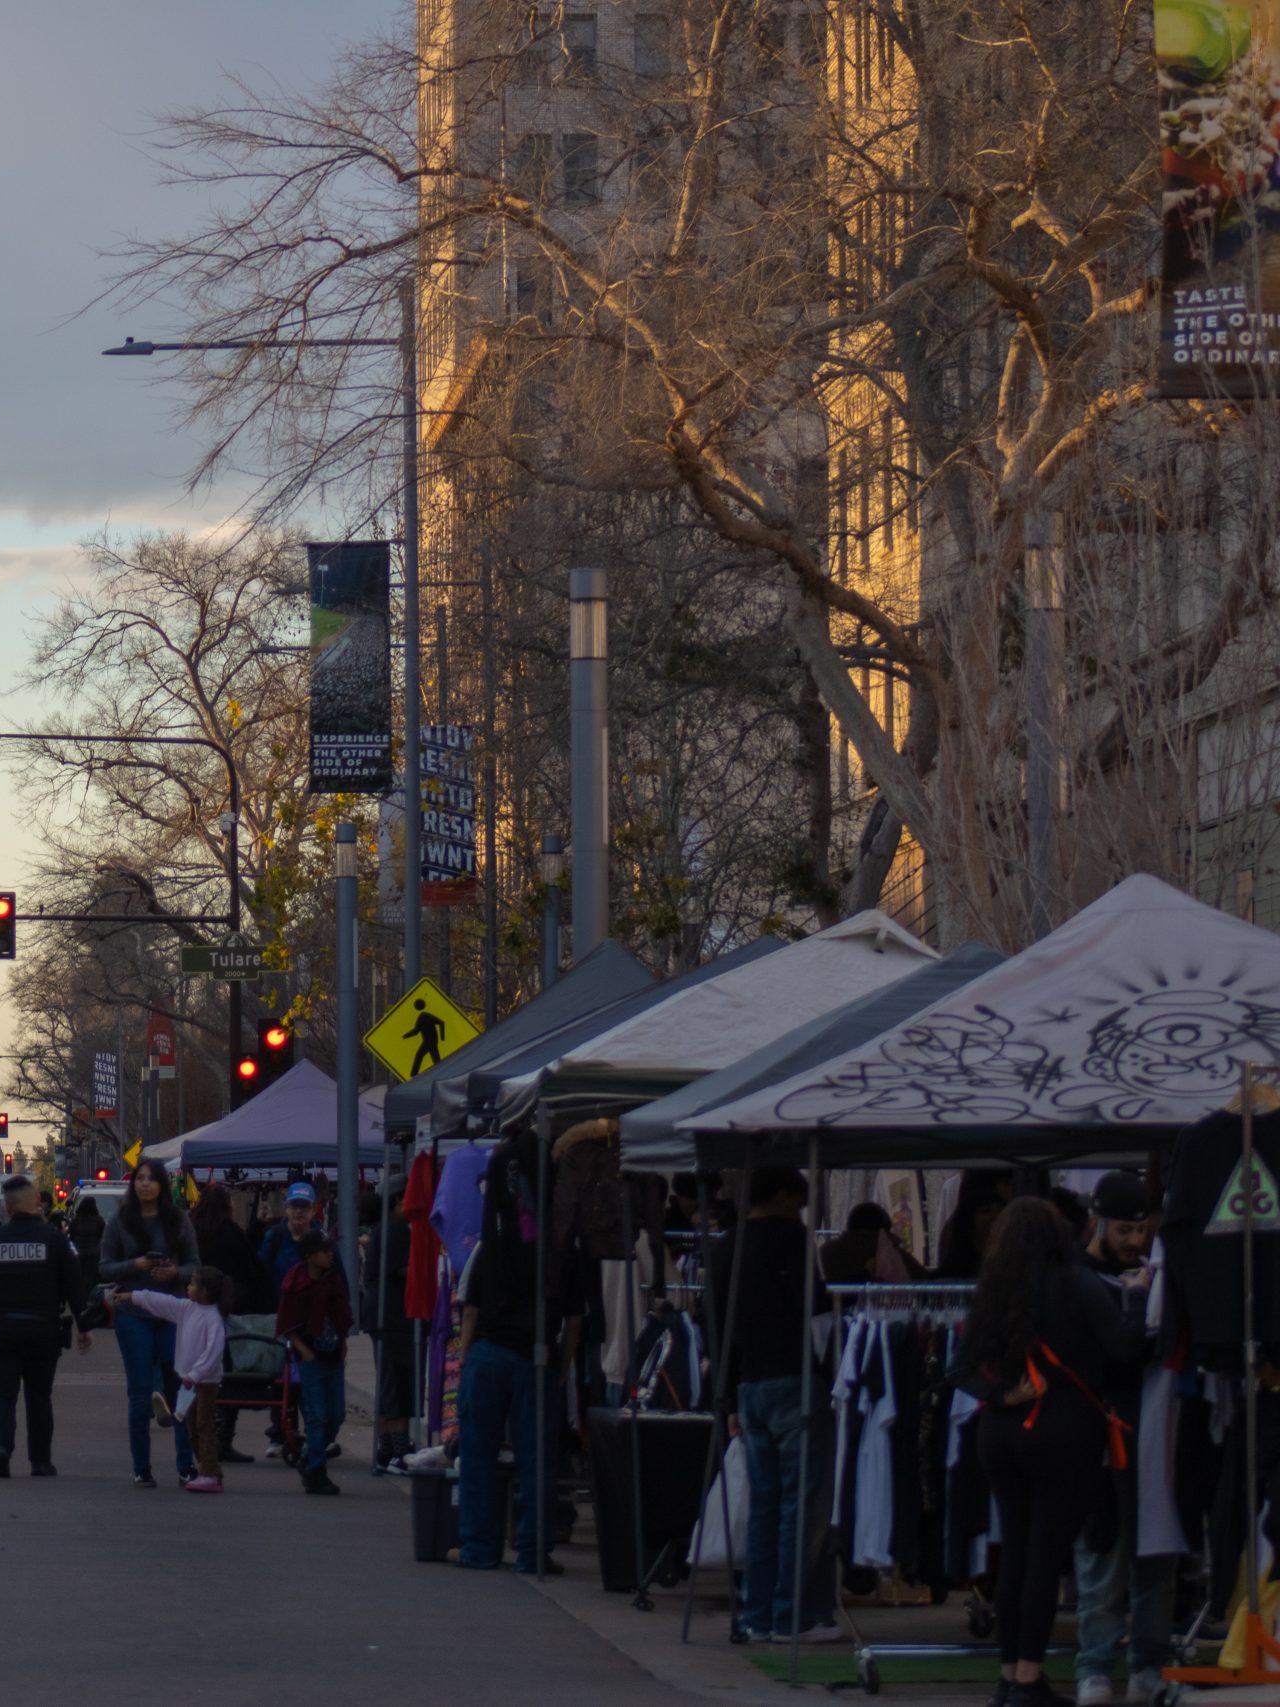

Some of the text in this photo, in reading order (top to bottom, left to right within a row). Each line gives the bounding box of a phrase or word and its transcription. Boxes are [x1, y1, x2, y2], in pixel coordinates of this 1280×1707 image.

[1173, 286, 1245, 304] TASTE
[1174, 312, 1280, 331] THE OTH
[1174, 331, 1228, 347] SIDE
[313, 735, 389, 743] EXPERIENCE
[313, 749, 382, 758] THE OTHER
[313, 758, 362, 767] SIDE OF
[313, 767, 377, 776] ORDINARY
[209, 952, 261, 967] Tulare
[0, 1243, 42, 1260] POLICE
